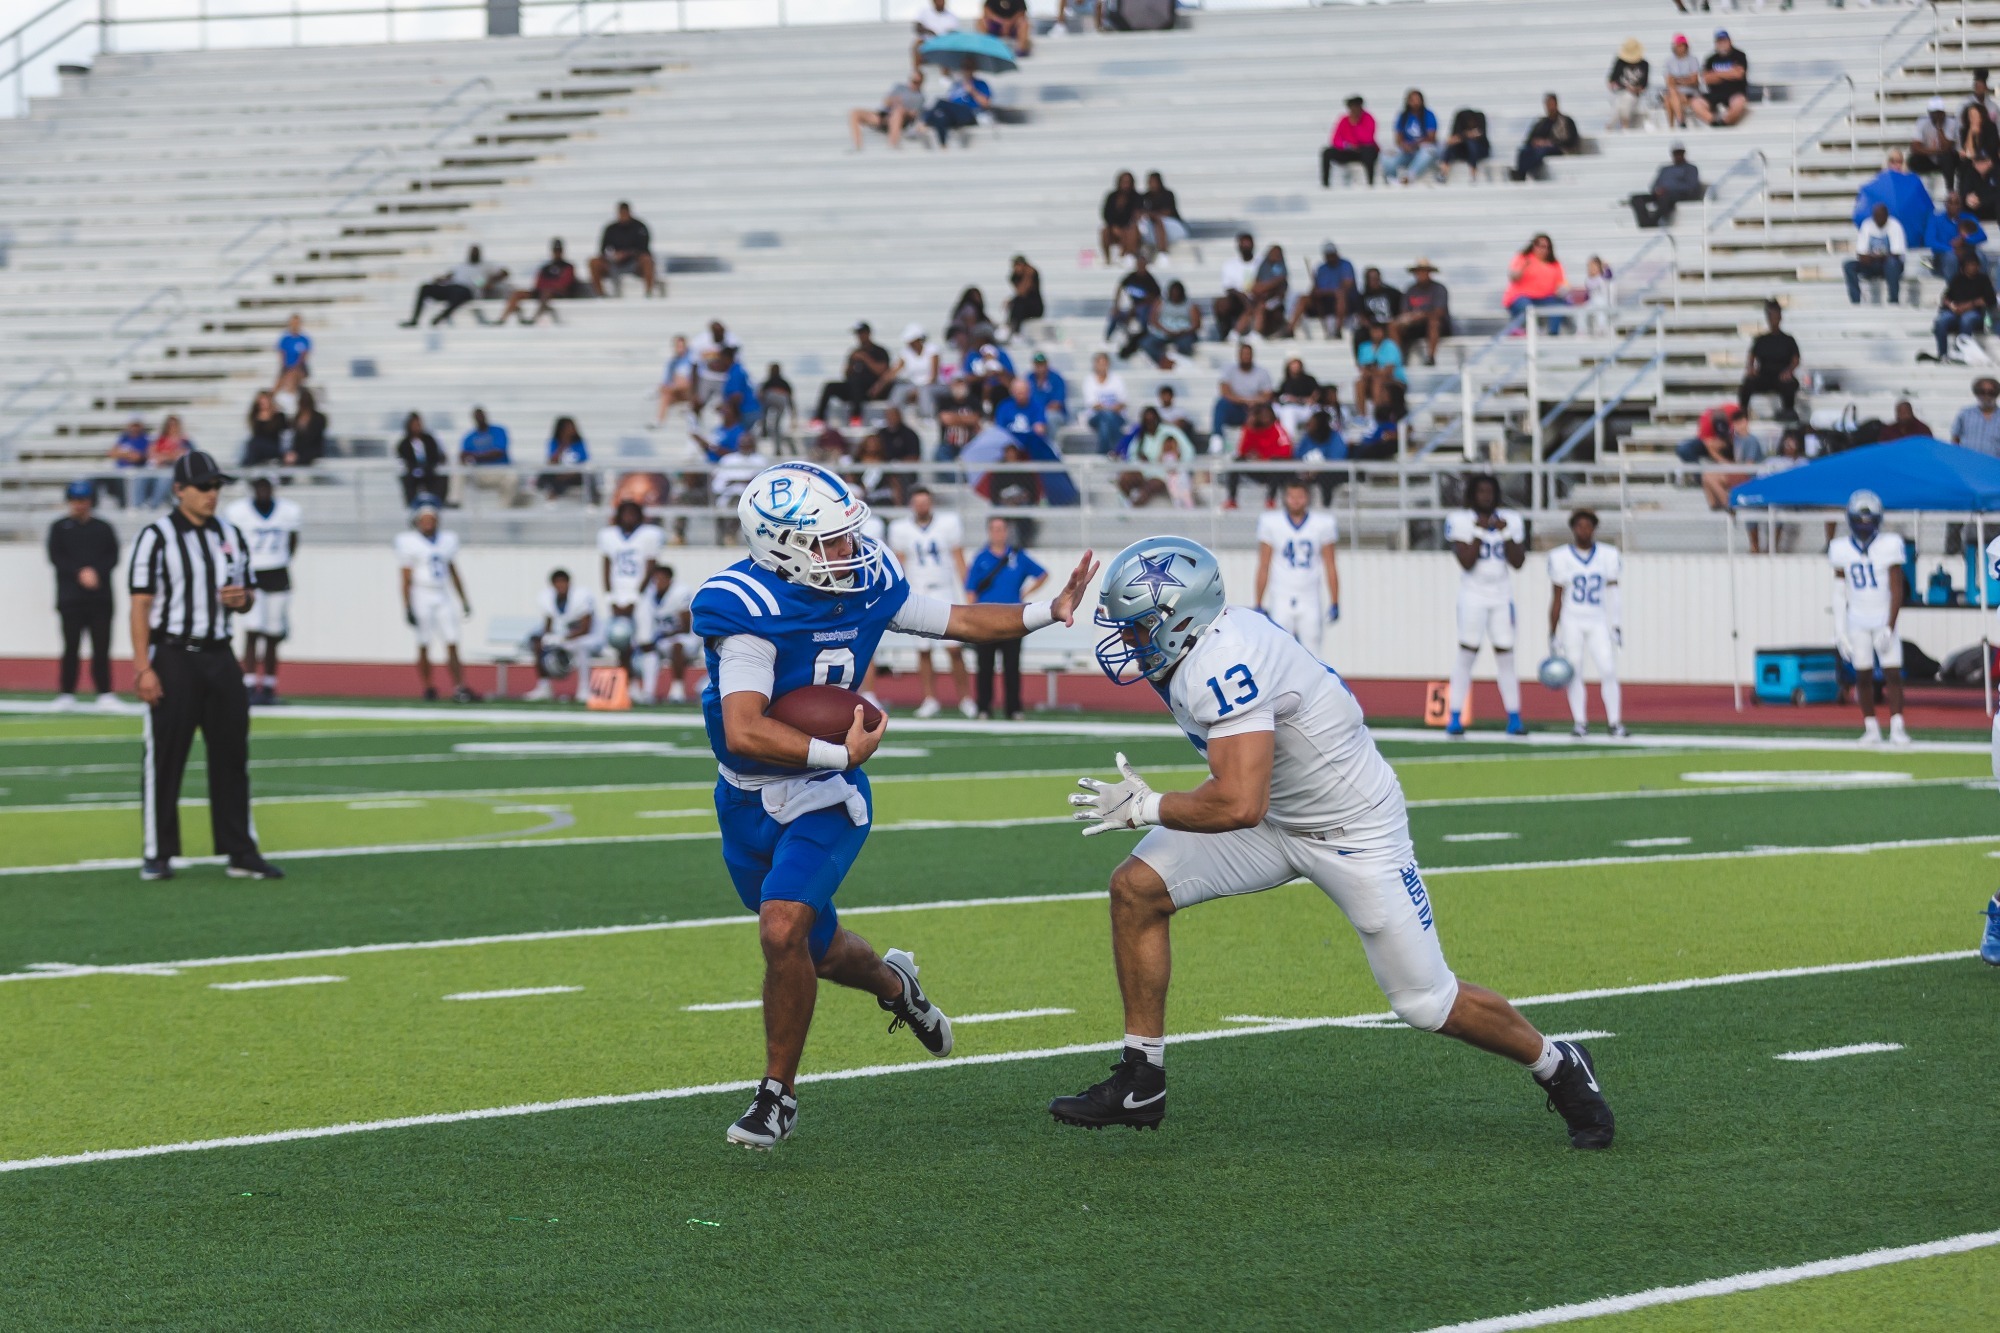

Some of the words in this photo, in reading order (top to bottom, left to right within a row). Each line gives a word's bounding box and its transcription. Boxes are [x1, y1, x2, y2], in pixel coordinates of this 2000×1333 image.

[770, 477, 793, 510] B
[1283, 539, 1313, 568] 43
[1206, 663, 1259, 717] 13
[1399, 861, 1433, 931] KILGORE
